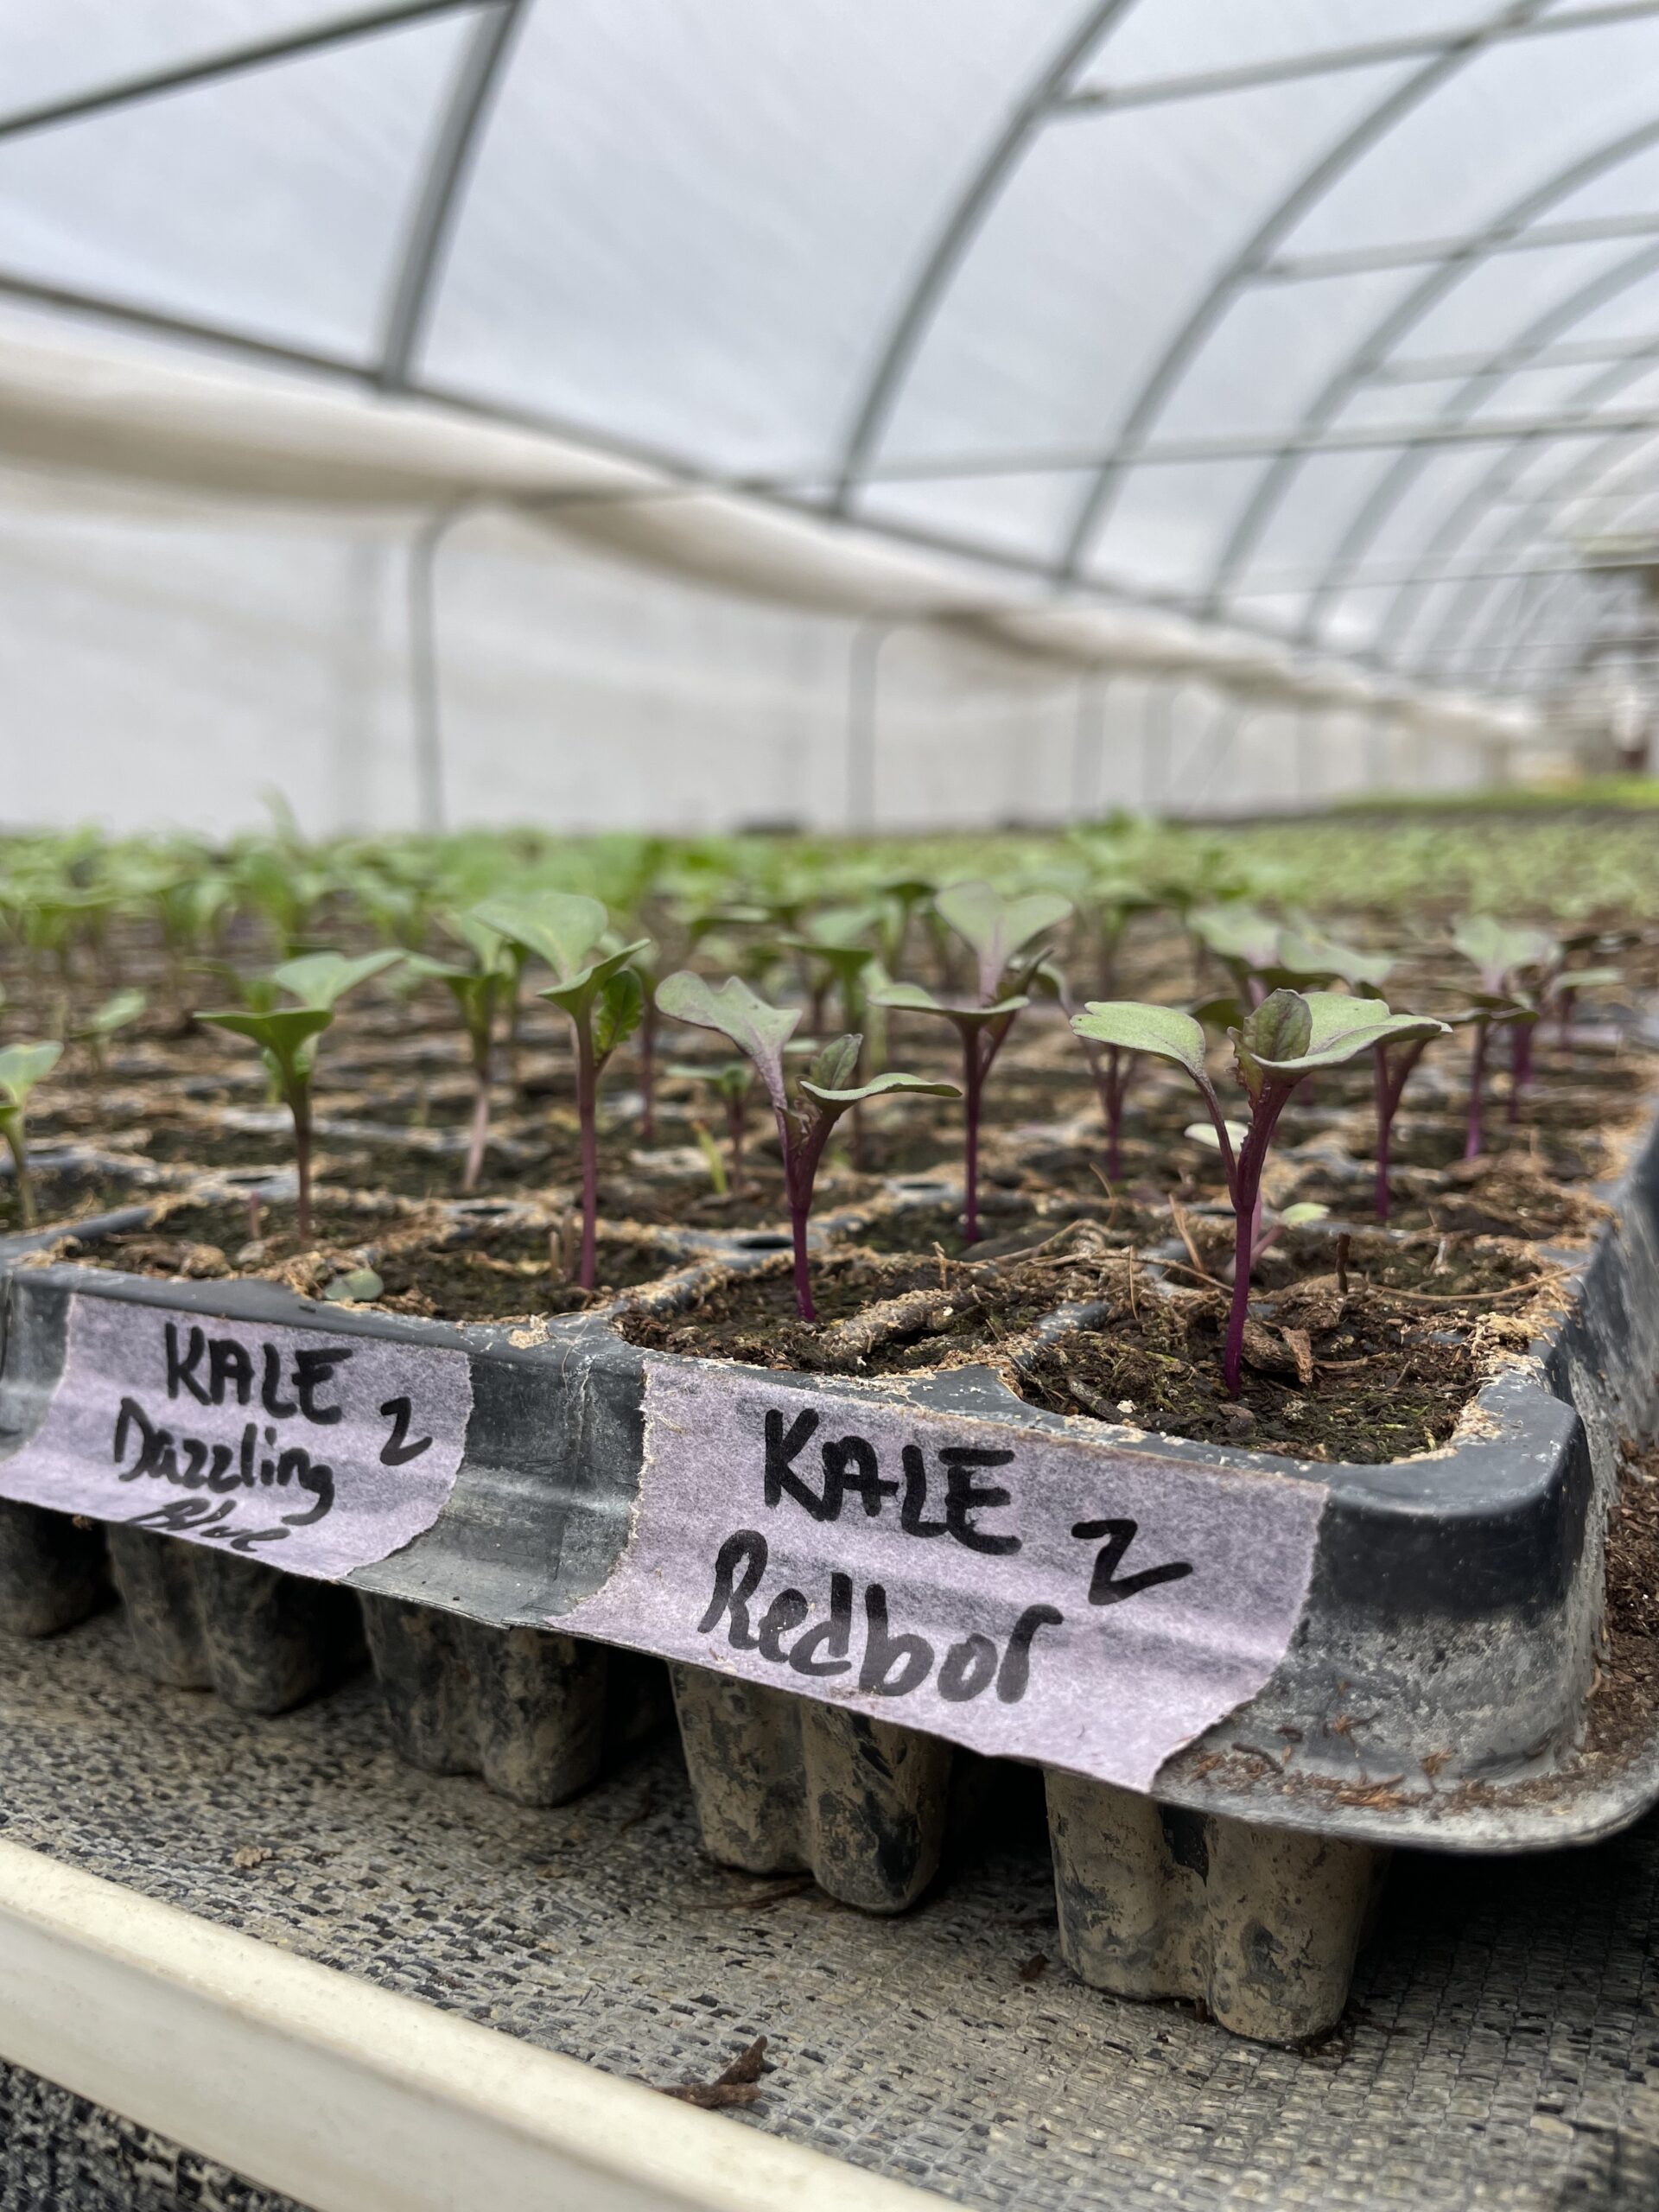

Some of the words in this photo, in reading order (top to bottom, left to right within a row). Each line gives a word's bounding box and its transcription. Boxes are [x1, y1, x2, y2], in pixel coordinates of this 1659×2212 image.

[113, 1396, 335, 1527] Dazzling
[165, 1322, 353, 1425] KALE
[380, 1396, 432, 1466] 2
[763, 1408, 1023, 1555] KALE
[1071, 1518, 1194, 1605] 2
[696, 1529, 1065, 1704] Redbor
